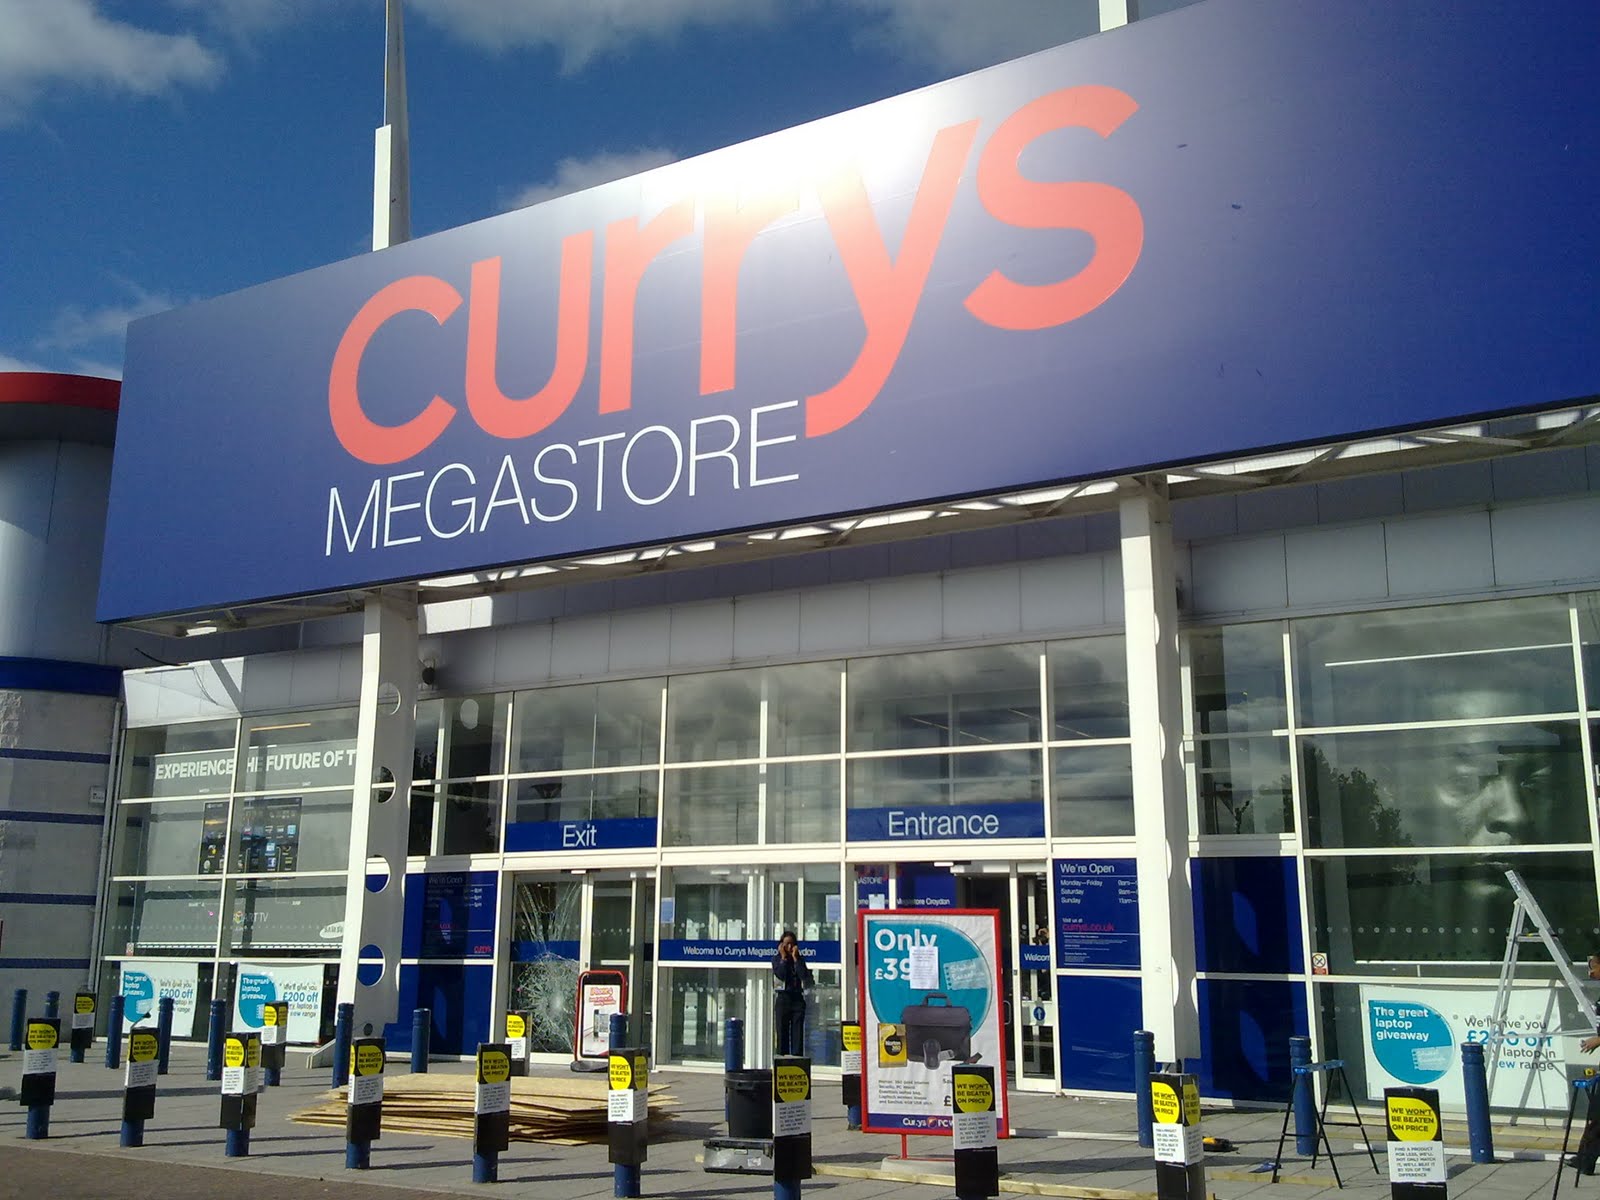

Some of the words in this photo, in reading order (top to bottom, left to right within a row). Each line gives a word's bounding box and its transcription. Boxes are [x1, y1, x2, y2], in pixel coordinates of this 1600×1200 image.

[328, 84, 1144, 465] currys
[324, 400, 799, 556] MEGASTORE
[155, 758, 235, 780] EXPERIENCE
[266, 753, 321, 772] FUTURE
[323, 751, 345, 767] OF
[887, 811, 1000, 837] Entrance
[562, 823, 598, 848] Exit
[1060, 863, 1088, 873] We're
[1089, 863, 1115, 874] Open
[874, 928, 938, 951] Only
[682, 946, 715, 956] Welcome
[715, 946, 723, 956] to
[723, 946, 747, 958] Currys
[747, 946, 780, 958] Megasto
[1024, 953, 1050, 961] Welcom
[160, 988, 180, 998] £200
[181, 988, 194, 998] off
[283, 991, 305, 1002] £200
[306, 991, 319, 1002] off
[1373, 1006, 1395, 1017] The
[1398, 1008, 1429, 1020] great
[1375, 1018, 1413, 1030] laptop
[1525, 1020, 1547, 1031] you
[1376, 1030, 1430, 1042] giveaway
[1503, 1047, 1540, 1058] laptop
[1545, 1048, 1556, 1058] in
[1497, 1060, 1516, 1068] ew
[1520, 1061, 1554, 1072] range
[1405, 1108, 1432, 1116] WON'T
